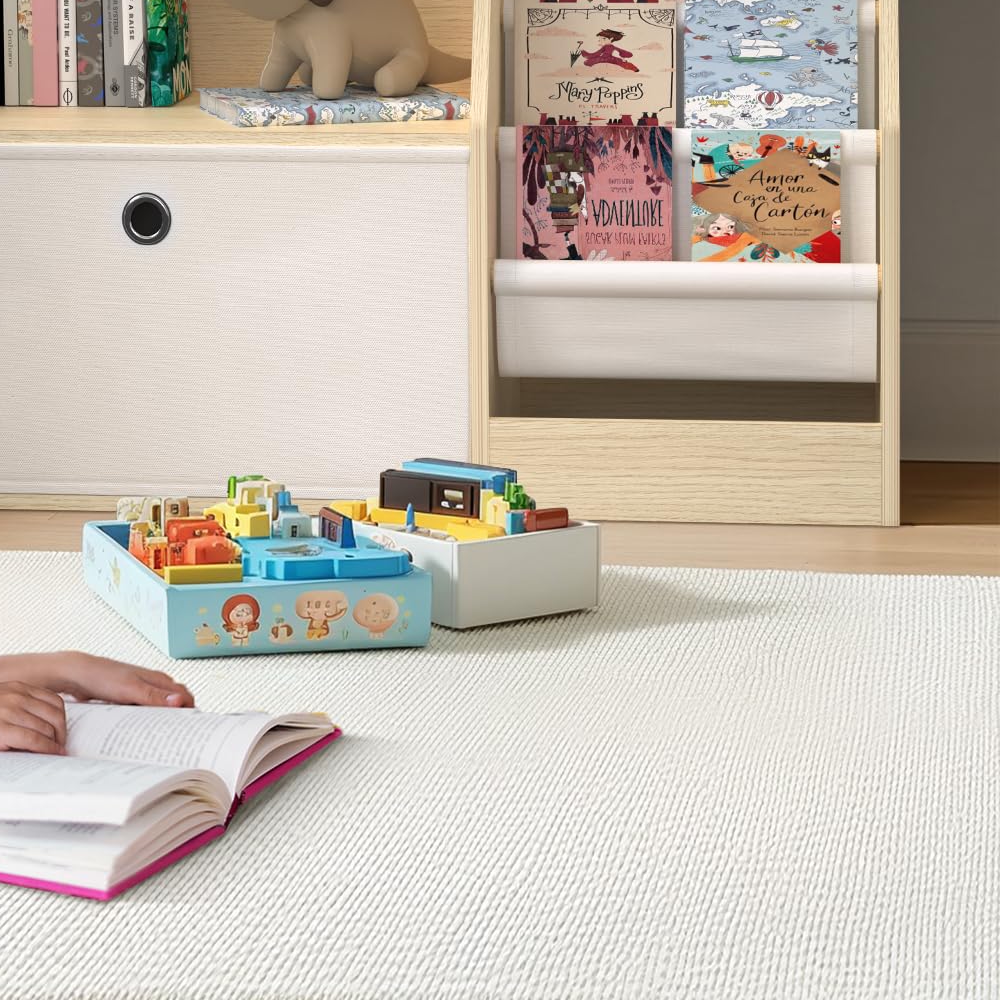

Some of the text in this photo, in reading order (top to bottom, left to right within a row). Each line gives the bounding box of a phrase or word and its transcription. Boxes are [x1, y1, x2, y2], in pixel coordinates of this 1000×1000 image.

[549, 81, 644, 104] Mary Poppins
[749, 170, 804, 186] Amor
[765, 185, 817, 194] en una
[772, 192, 792, 203] de
[754, 202, 830, 222] Cartón
